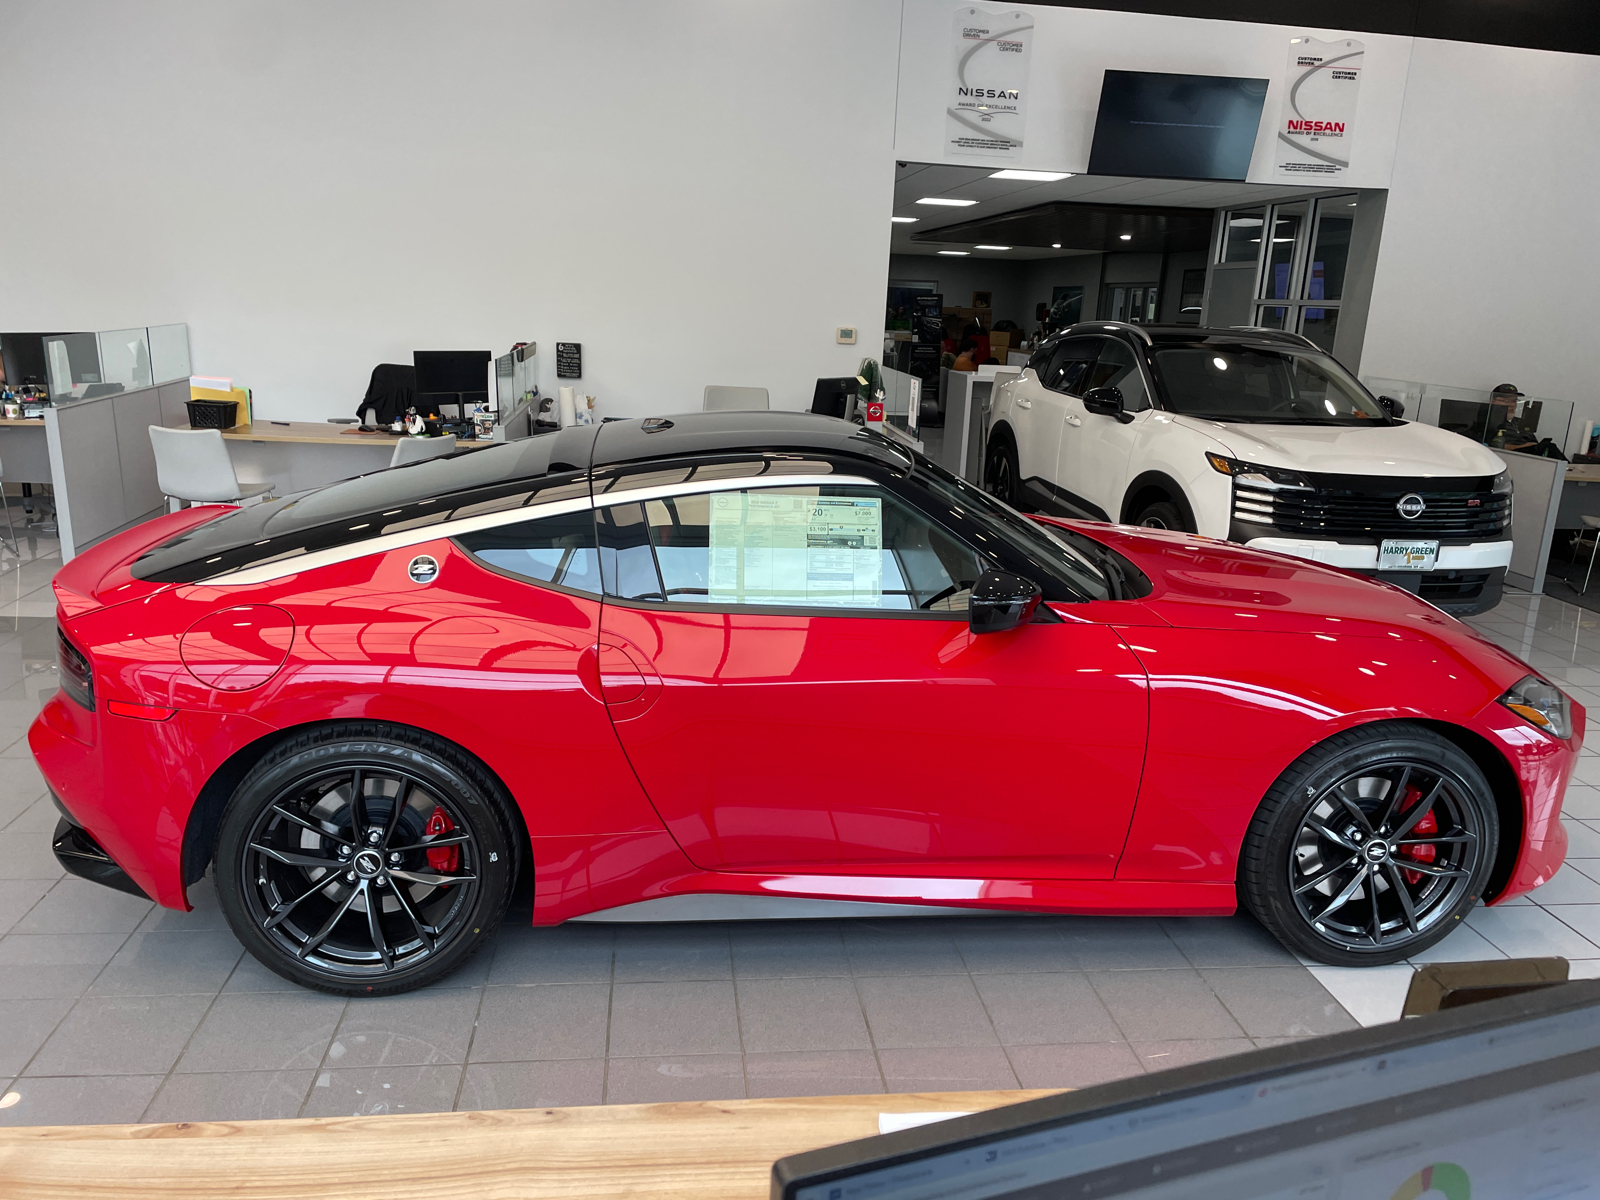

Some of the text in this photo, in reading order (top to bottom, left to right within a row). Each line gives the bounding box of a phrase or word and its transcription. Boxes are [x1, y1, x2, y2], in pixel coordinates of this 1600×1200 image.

[958, 87, 1019, 100] NISSAN
[1287, 120, 1345, 132] NISSAN
[812, 508, 823, 516] 20
[1396, 503, 1426, 511] NISSAN
[1383, 546, 1435, 555] HARRY GREEN
[299, 744, 413, 761] POTENZA
